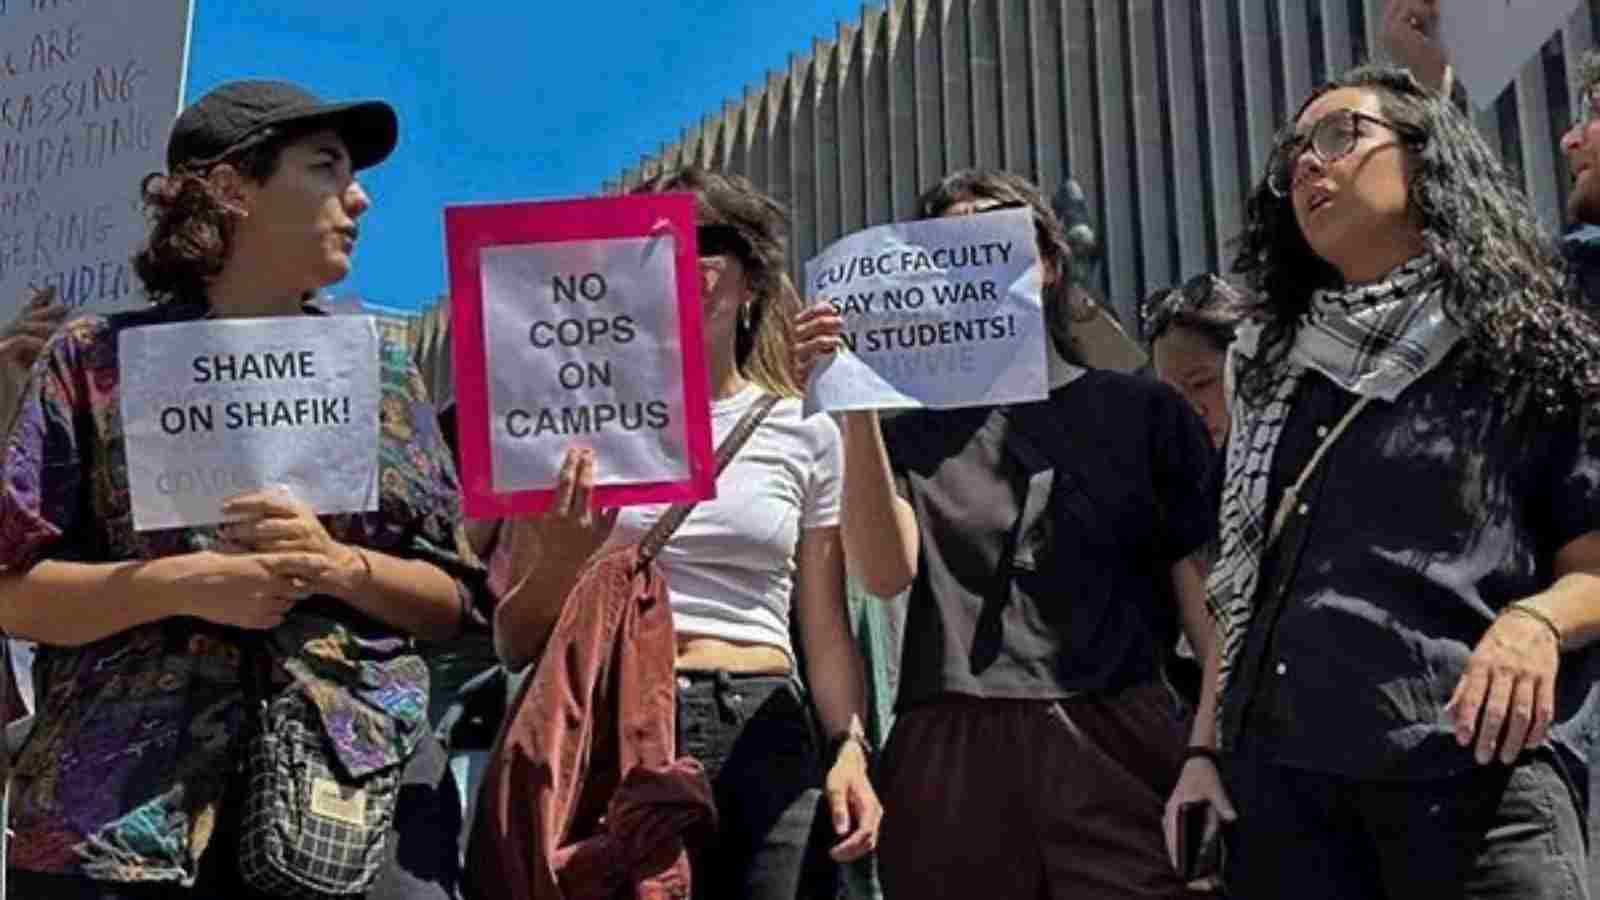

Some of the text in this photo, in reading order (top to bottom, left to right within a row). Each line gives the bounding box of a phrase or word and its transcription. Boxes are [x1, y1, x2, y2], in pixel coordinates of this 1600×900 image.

[900, 242, 1012, 272] FACULTY
[552, 273, 607, 303] NO
[830, 280, 998, 316] SAY NO WAR
[529, 316, 635, 349] COPS
[866, 315, 1016, 352] STUDENTS!
[193, 351, 315, 382] SHAME
[558, 361, 612, 390] ON
[161, 398, 350, 434] ON SHAFIK!
[505, 401, 670, 437] CAMPUS
